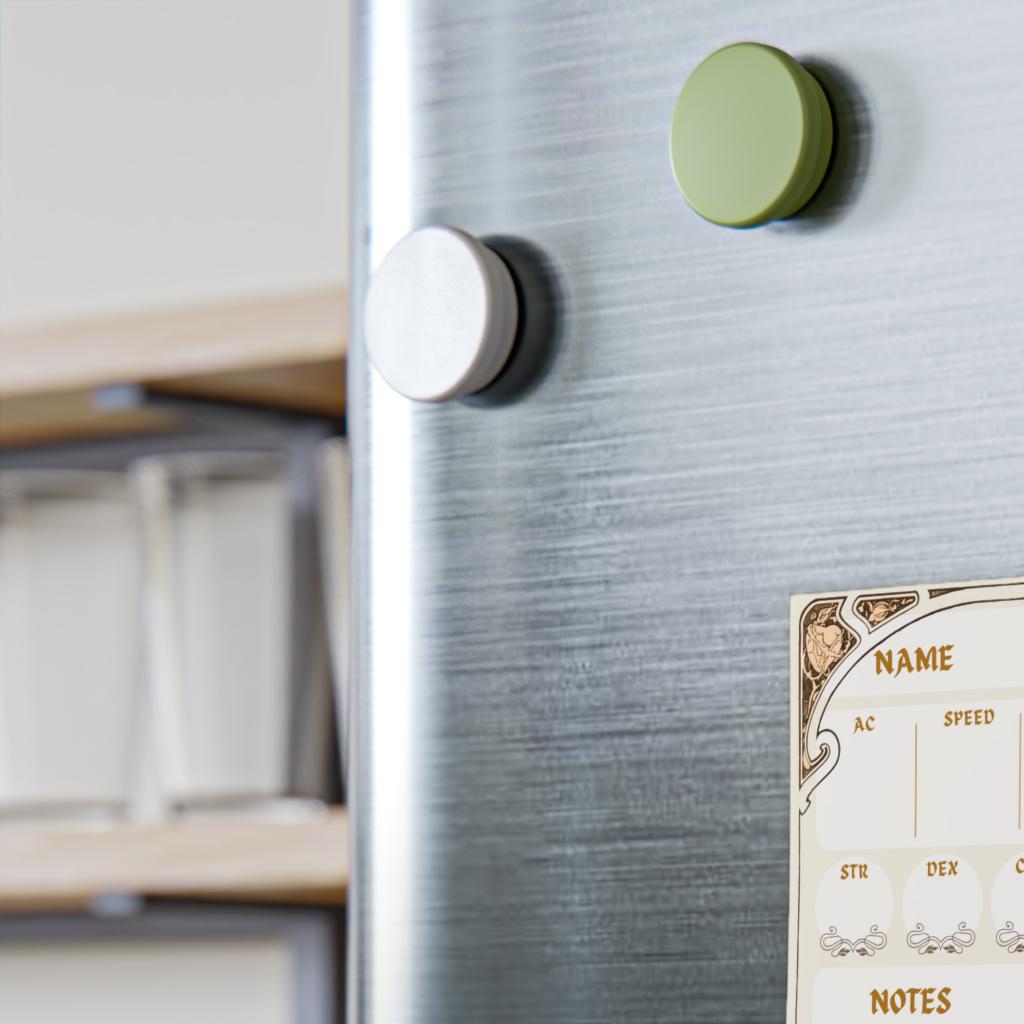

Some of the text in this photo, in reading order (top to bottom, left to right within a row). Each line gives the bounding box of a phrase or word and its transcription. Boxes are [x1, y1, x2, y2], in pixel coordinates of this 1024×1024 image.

[874, 644, 955, 678] NAME
[853, 715, 876, 733] AC
[943, 708, 995, 728] SPEED
[839, 862, 869, 881] STR
[926, 859, 959, 878] DEX
[869, 986, 953, 1016] NOTES
